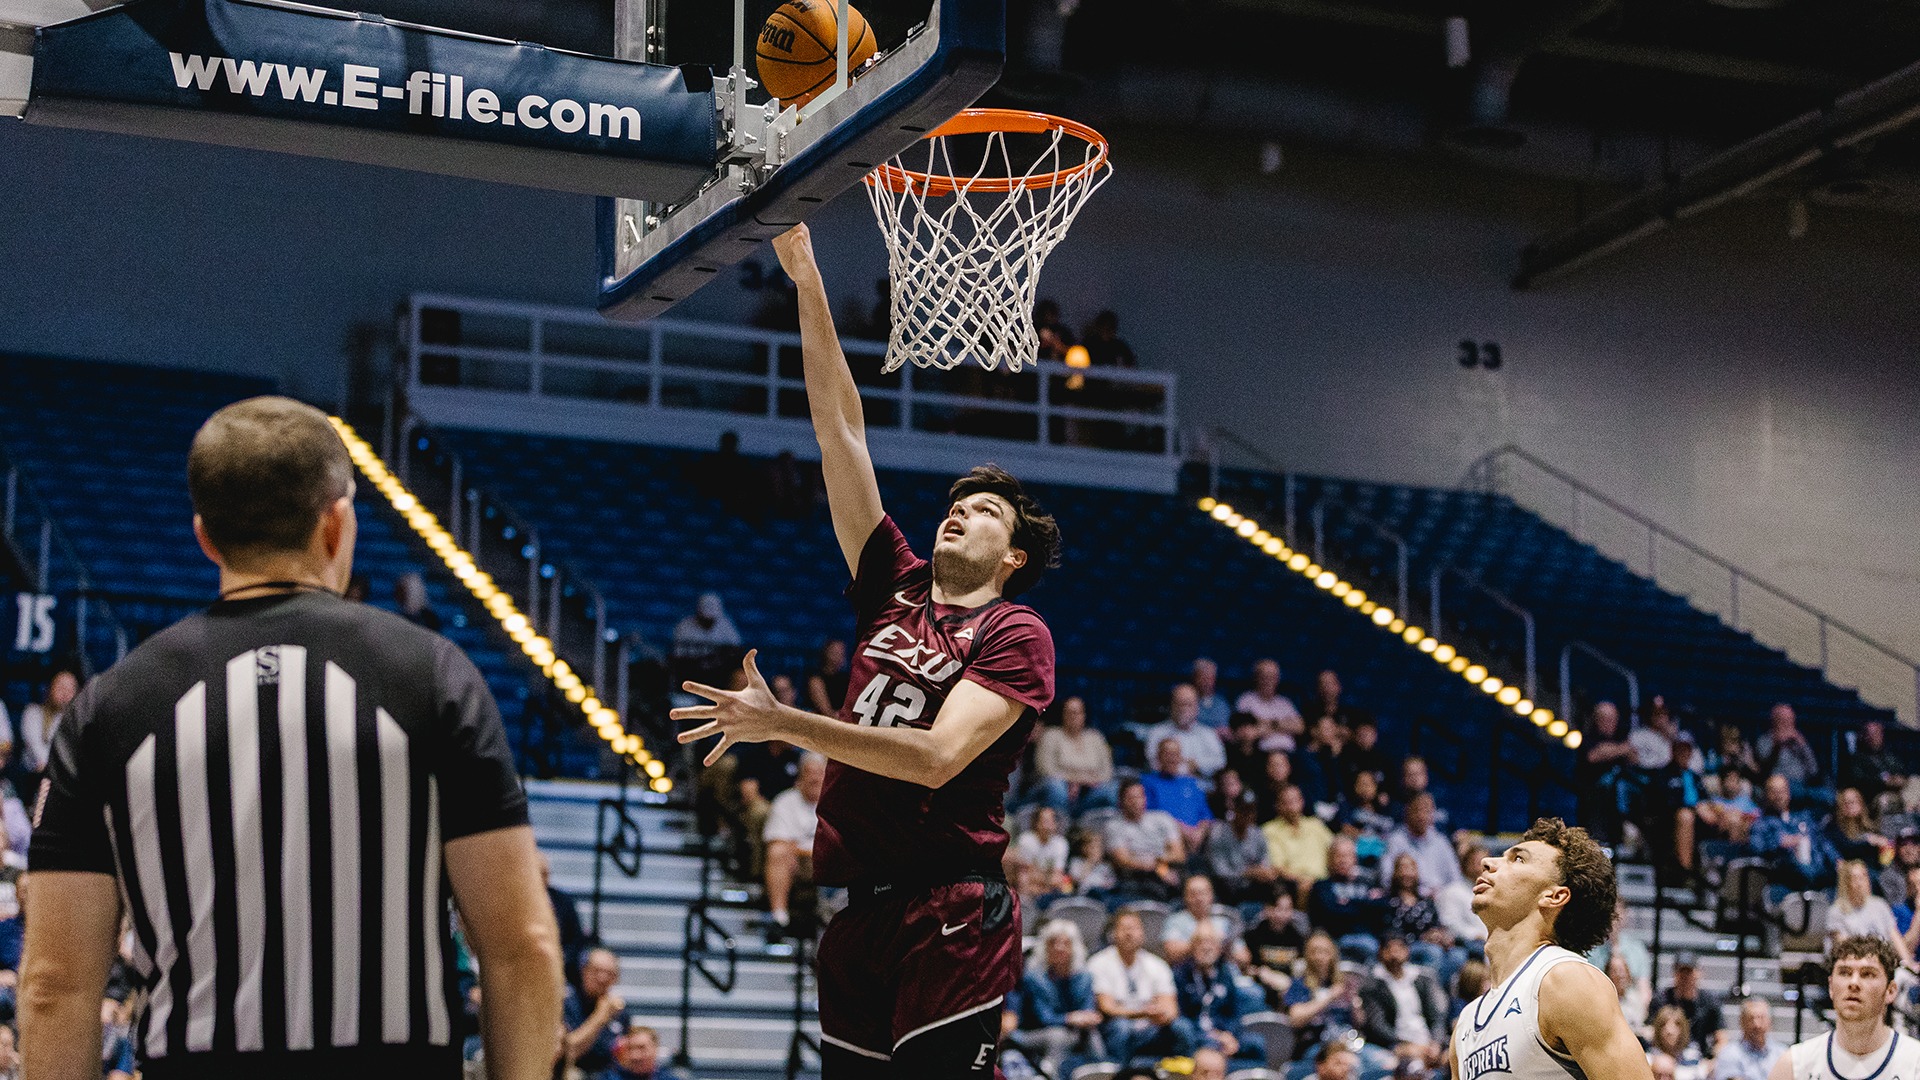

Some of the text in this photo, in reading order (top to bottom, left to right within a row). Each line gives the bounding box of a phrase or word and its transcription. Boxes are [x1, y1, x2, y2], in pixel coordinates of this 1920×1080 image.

[169, 52, 641, 141] www.E-file.com
[1459, 340, 1502, 370] 33
[15, 592, 57, 652] 15
[863, 624, 963, 682] EKU
[853, 673, 926, 728] 42
